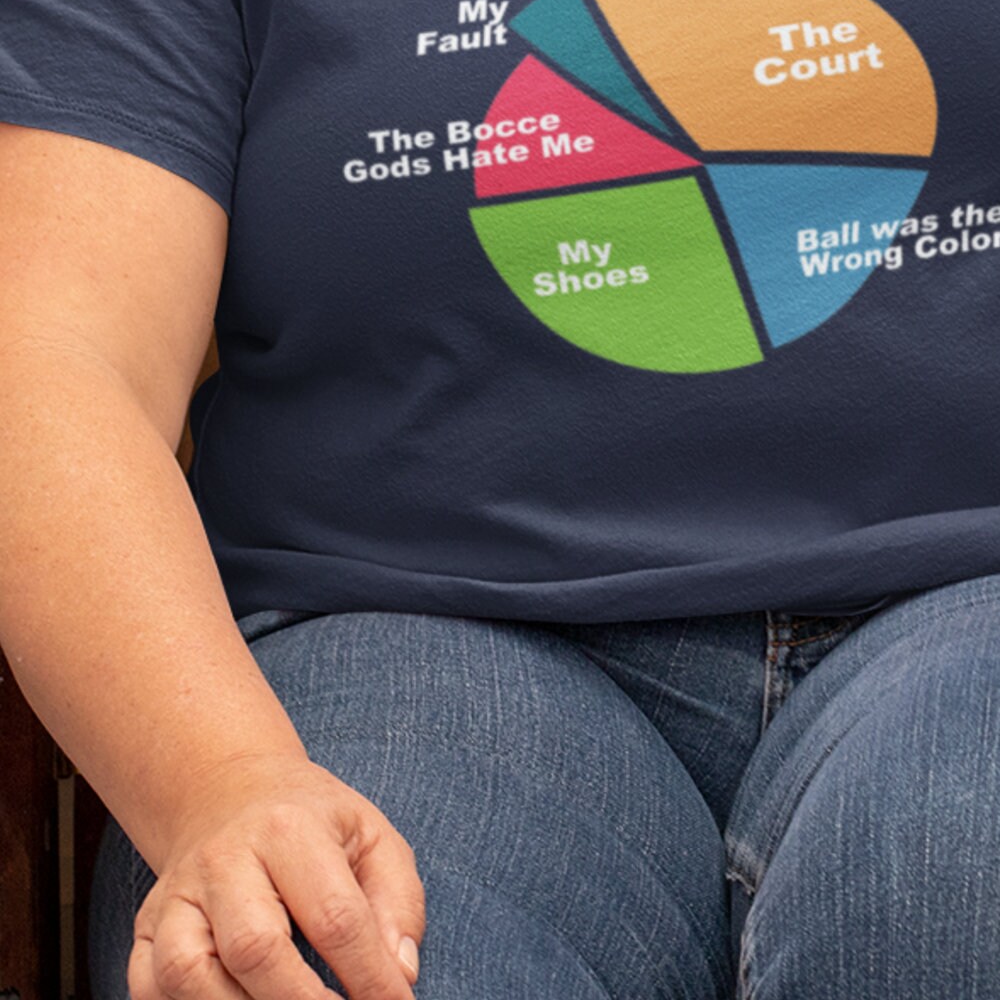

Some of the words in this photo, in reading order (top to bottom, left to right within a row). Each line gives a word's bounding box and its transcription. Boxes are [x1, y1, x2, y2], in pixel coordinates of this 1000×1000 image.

[416, 22, 508, 56] Fault
[768, 21, 858, 52] The
[753, 43, 884, 87] Court
[368, 129, 435, 154] The
[447, 114, 561, 144] Bocce
[343, 157, 431, 183] Gods
[443, 144, 529, 172] Hate
[541, 132, 595, 159] Me
[797, 220, 860, 253] Ball
[871, 215, 939, 240] was
[557, 239, 612, 267] My
[800, 246, 903, 278] Wrong
[533, 265, 650, 297] Shoes
